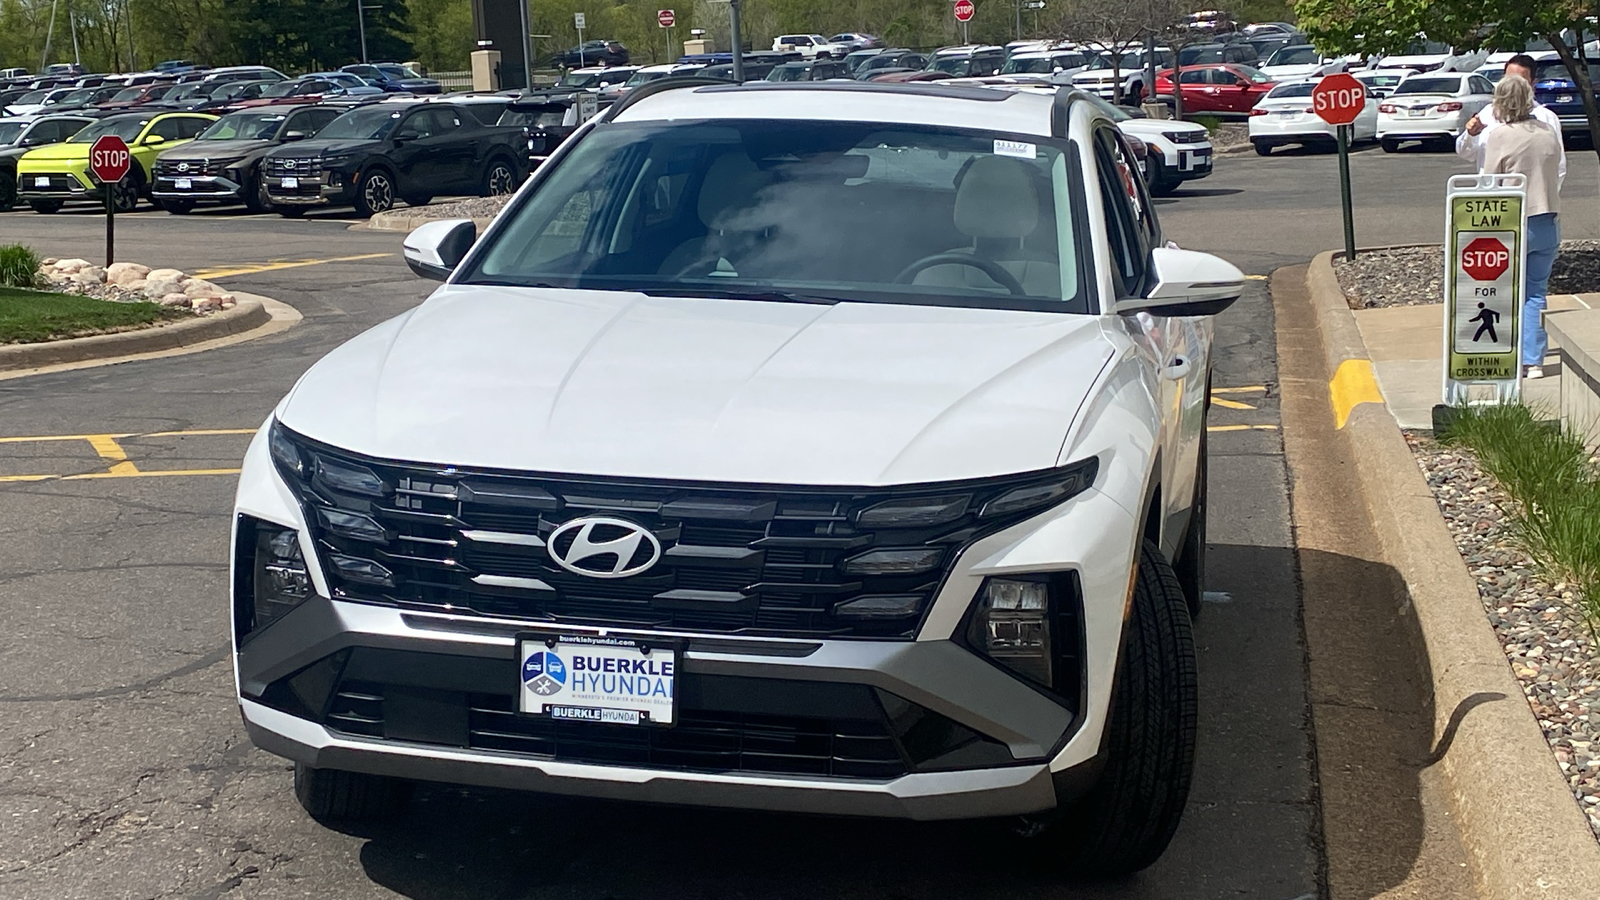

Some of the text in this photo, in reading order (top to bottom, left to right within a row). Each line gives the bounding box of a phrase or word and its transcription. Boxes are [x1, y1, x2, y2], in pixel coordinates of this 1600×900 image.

[955, 5, 973, 15] STOP
[1316, 88, 1362, 111] STOP
[583, 106, 595, 114] LIMIT
[94, 150, 128, 168] STOP
[1465, 200, 1508, 213] STATE
[1471, 216, 1501, 227] LAW
[1463, 251, 1509, 268] STOP
[1475, 288, 1497, 297] FOR
[1467, 357, 1500, 366] WITHIN
[1456, 368, 1510, 377] CROSSWALK
[559, 635, 636, 646] buerklehyundai.com
[572, 655, 673, 677] BUERKLE
[553, 707, 638, 722] BUERKLE HYUNDAI
